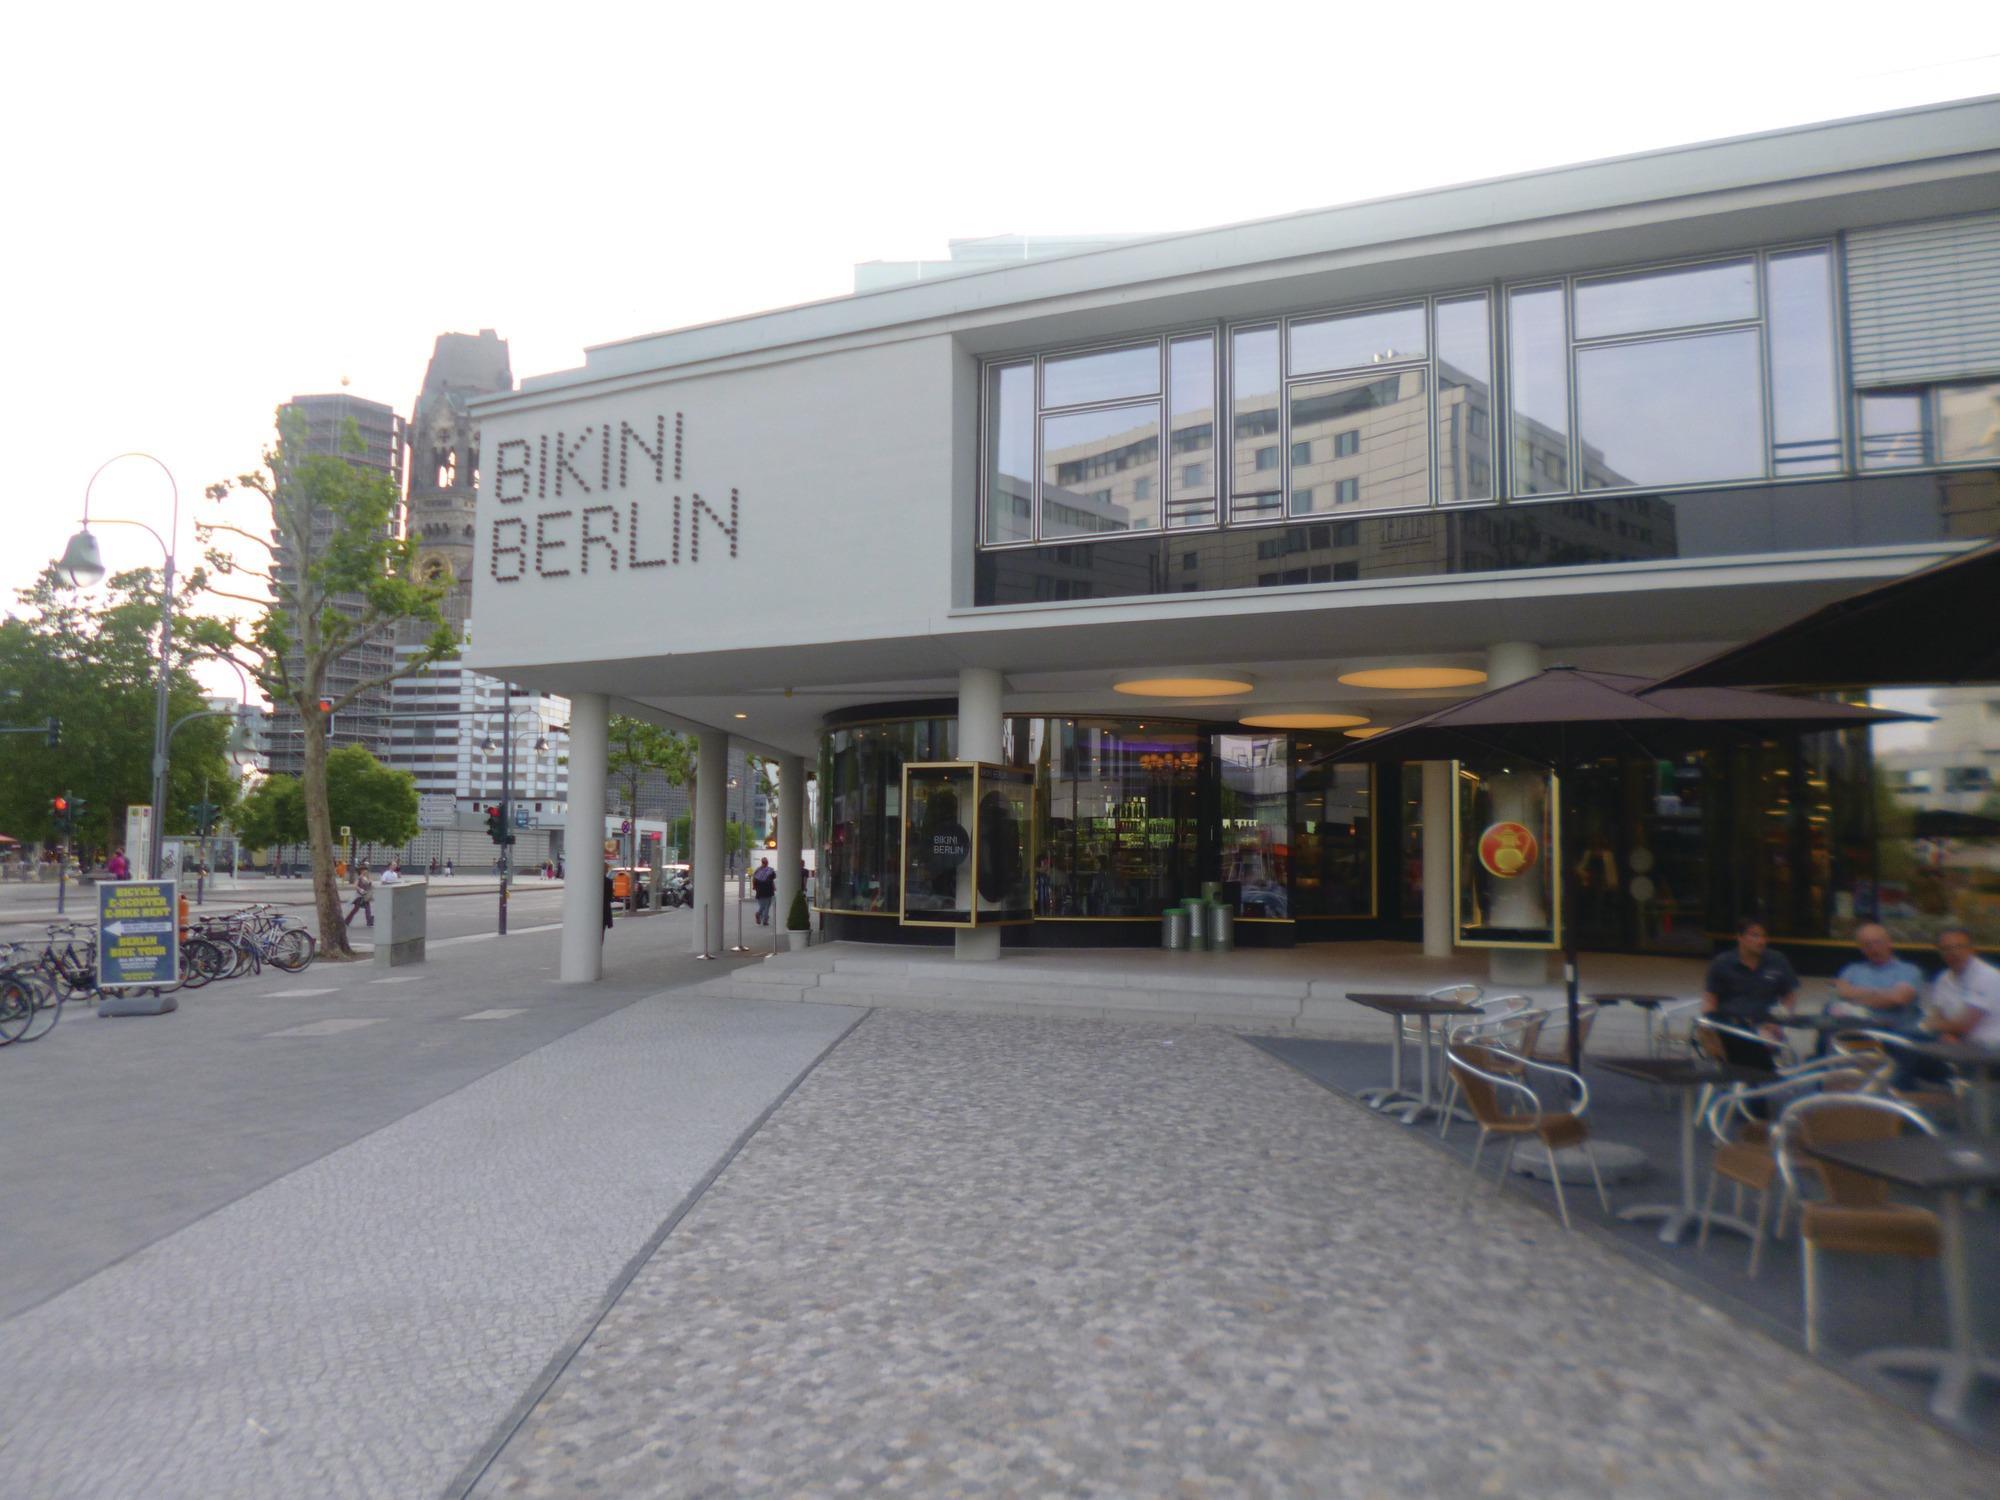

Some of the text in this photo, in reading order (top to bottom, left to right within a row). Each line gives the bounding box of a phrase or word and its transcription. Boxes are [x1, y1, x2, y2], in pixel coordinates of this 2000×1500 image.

[495, 412, 683, 504] BIKINI
[491, 487, 739, 582] BERLIN
[933, 835, 958, 845] BIKINI
[933, 845, 964, 855] BERLIN
[116, 887, 160, 897] BICYCLE
[109, 897, 167, 907] E-SCOOTER
[104, 907, 171, 918] E-BIKE RENT
[118, 936, 156, 946] BERLIN
[110, 946, 166, 957] BIKE TOUR
